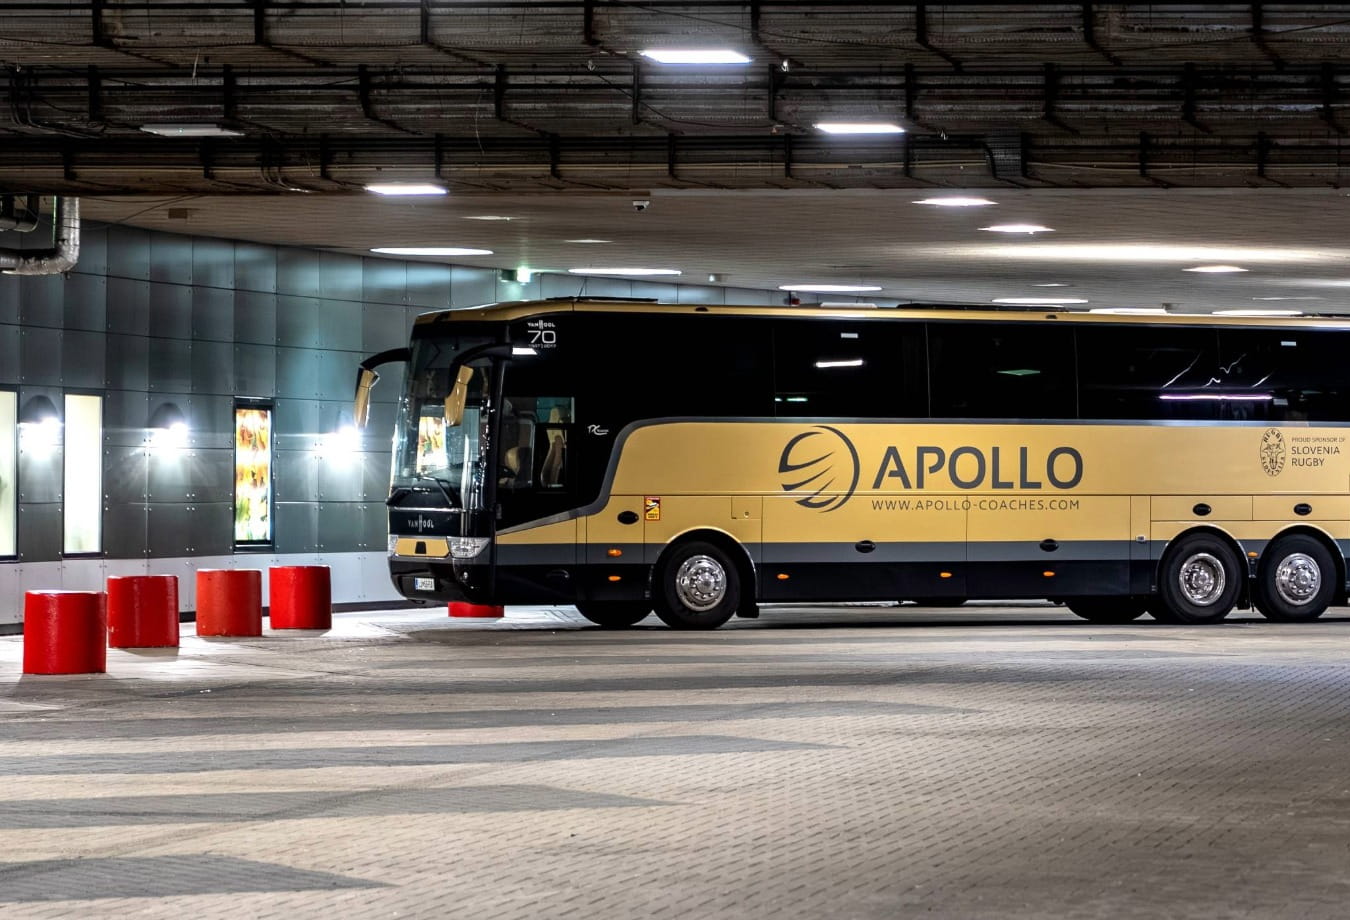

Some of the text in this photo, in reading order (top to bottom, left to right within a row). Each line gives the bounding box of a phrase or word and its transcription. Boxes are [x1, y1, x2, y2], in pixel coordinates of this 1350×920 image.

[527, 330, 556, 344] 70
[1291, 446, 1340, 455] SLOVENIA
[872, 446, 1084, 490] APOLLO
[1291, 457, 1325, 467] RUGBY
[872, 499, 1081, 511] WWW.APOLLO-COACHES.COM
